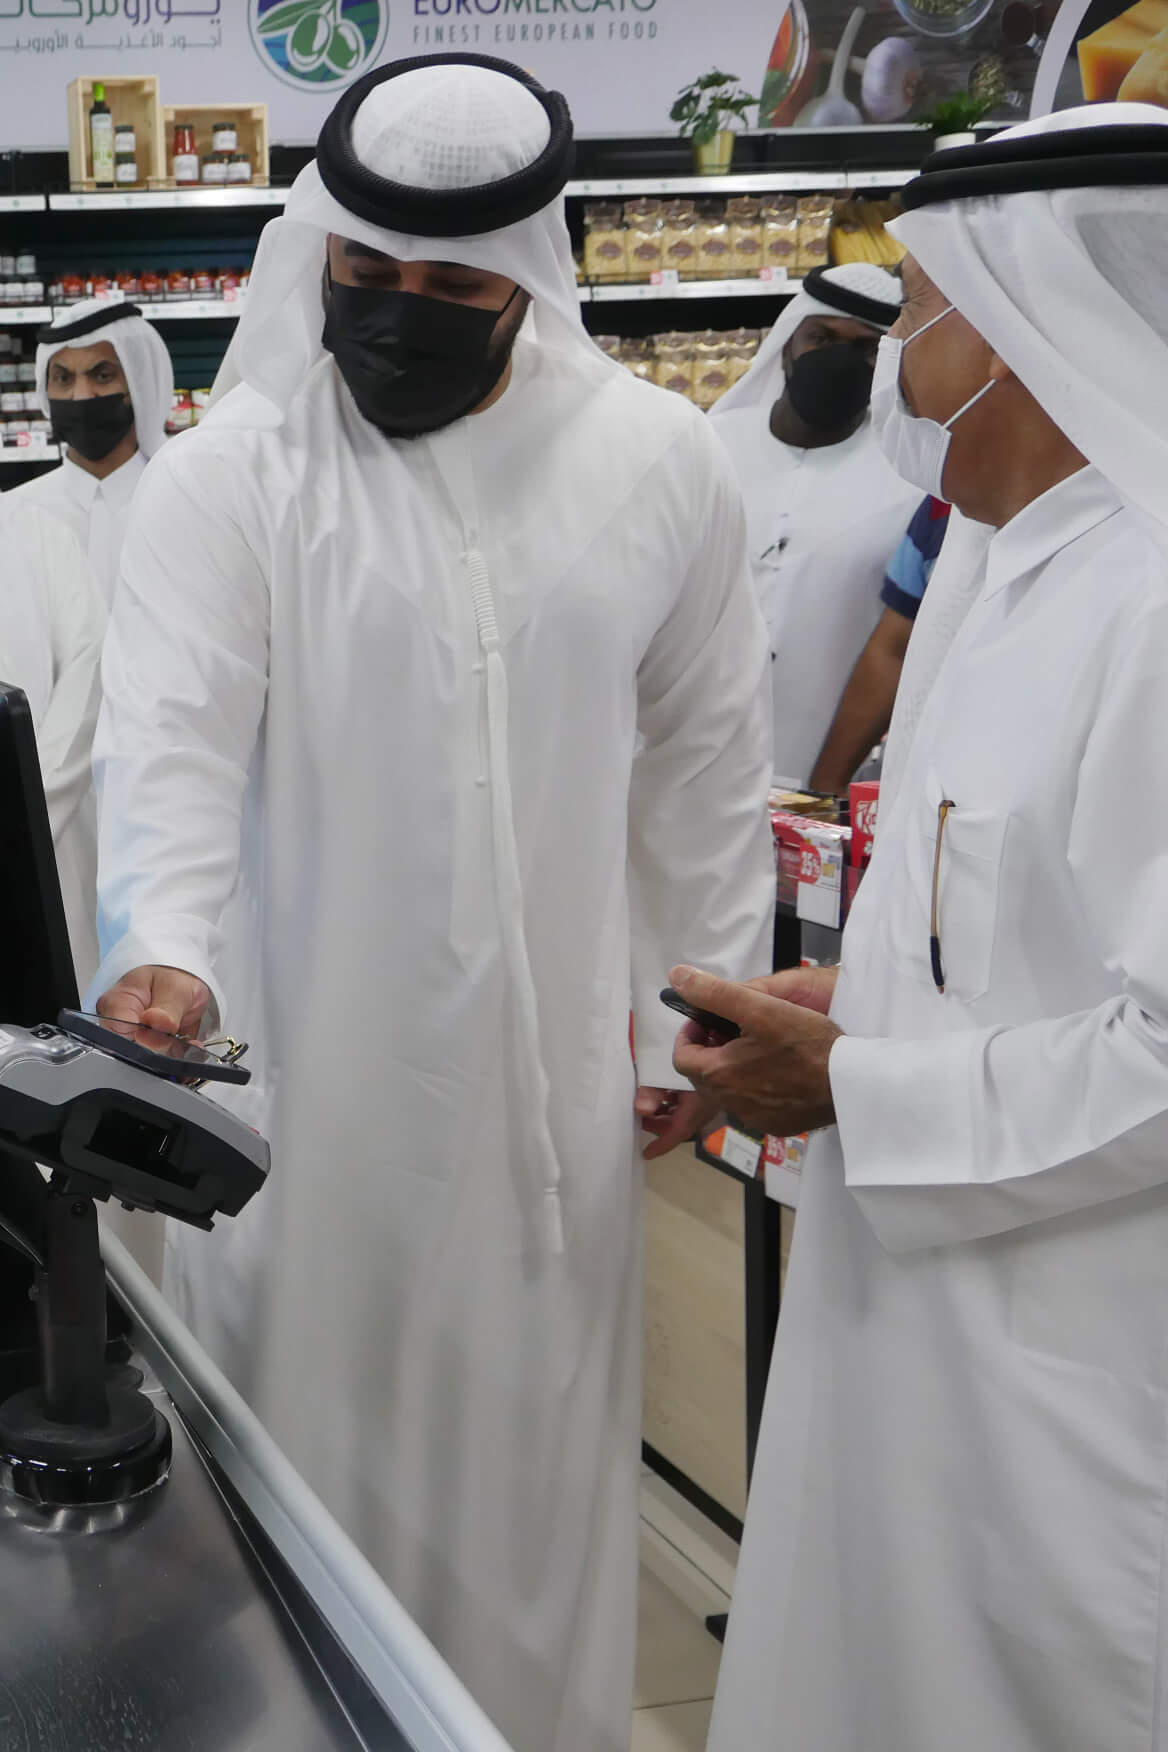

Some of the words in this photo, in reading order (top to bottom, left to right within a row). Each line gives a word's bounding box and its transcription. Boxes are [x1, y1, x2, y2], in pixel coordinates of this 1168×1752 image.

[413, 25, 480, 43] FINEST
[495, 23, 595, 42] EUROPEAN
[609, 21, 658, 40] FOOD
